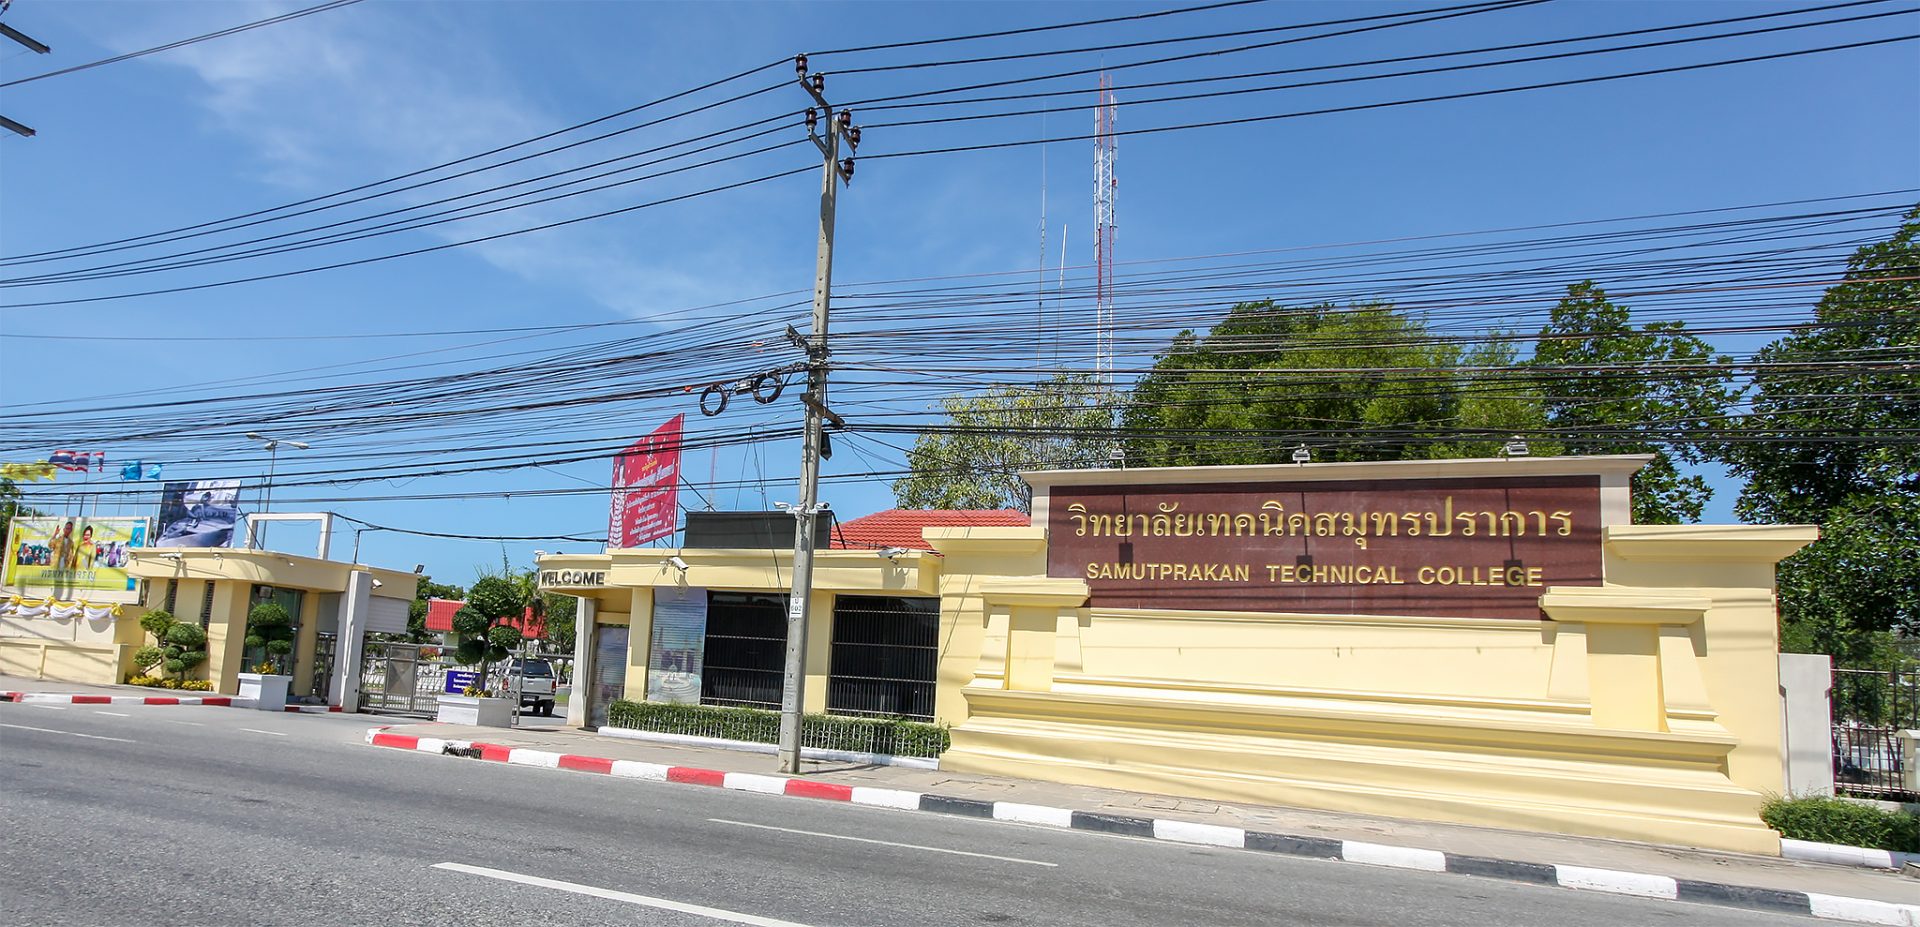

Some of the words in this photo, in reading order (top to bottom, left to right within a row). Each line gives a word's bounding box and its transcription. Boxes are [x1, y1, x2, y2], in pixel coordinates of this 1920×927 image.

[1068, 496, 1573, 549] วิทยาลัยเทคนิคสมุทรปราการ
[541, 570, 605, 586] WELCOME
[1086, 562, 1250, 582] SAMUTPRAKAN
[1266, 564, 1405, 584] TECHNICAL
[1417, 566, 1543, 587] COLLEGE
